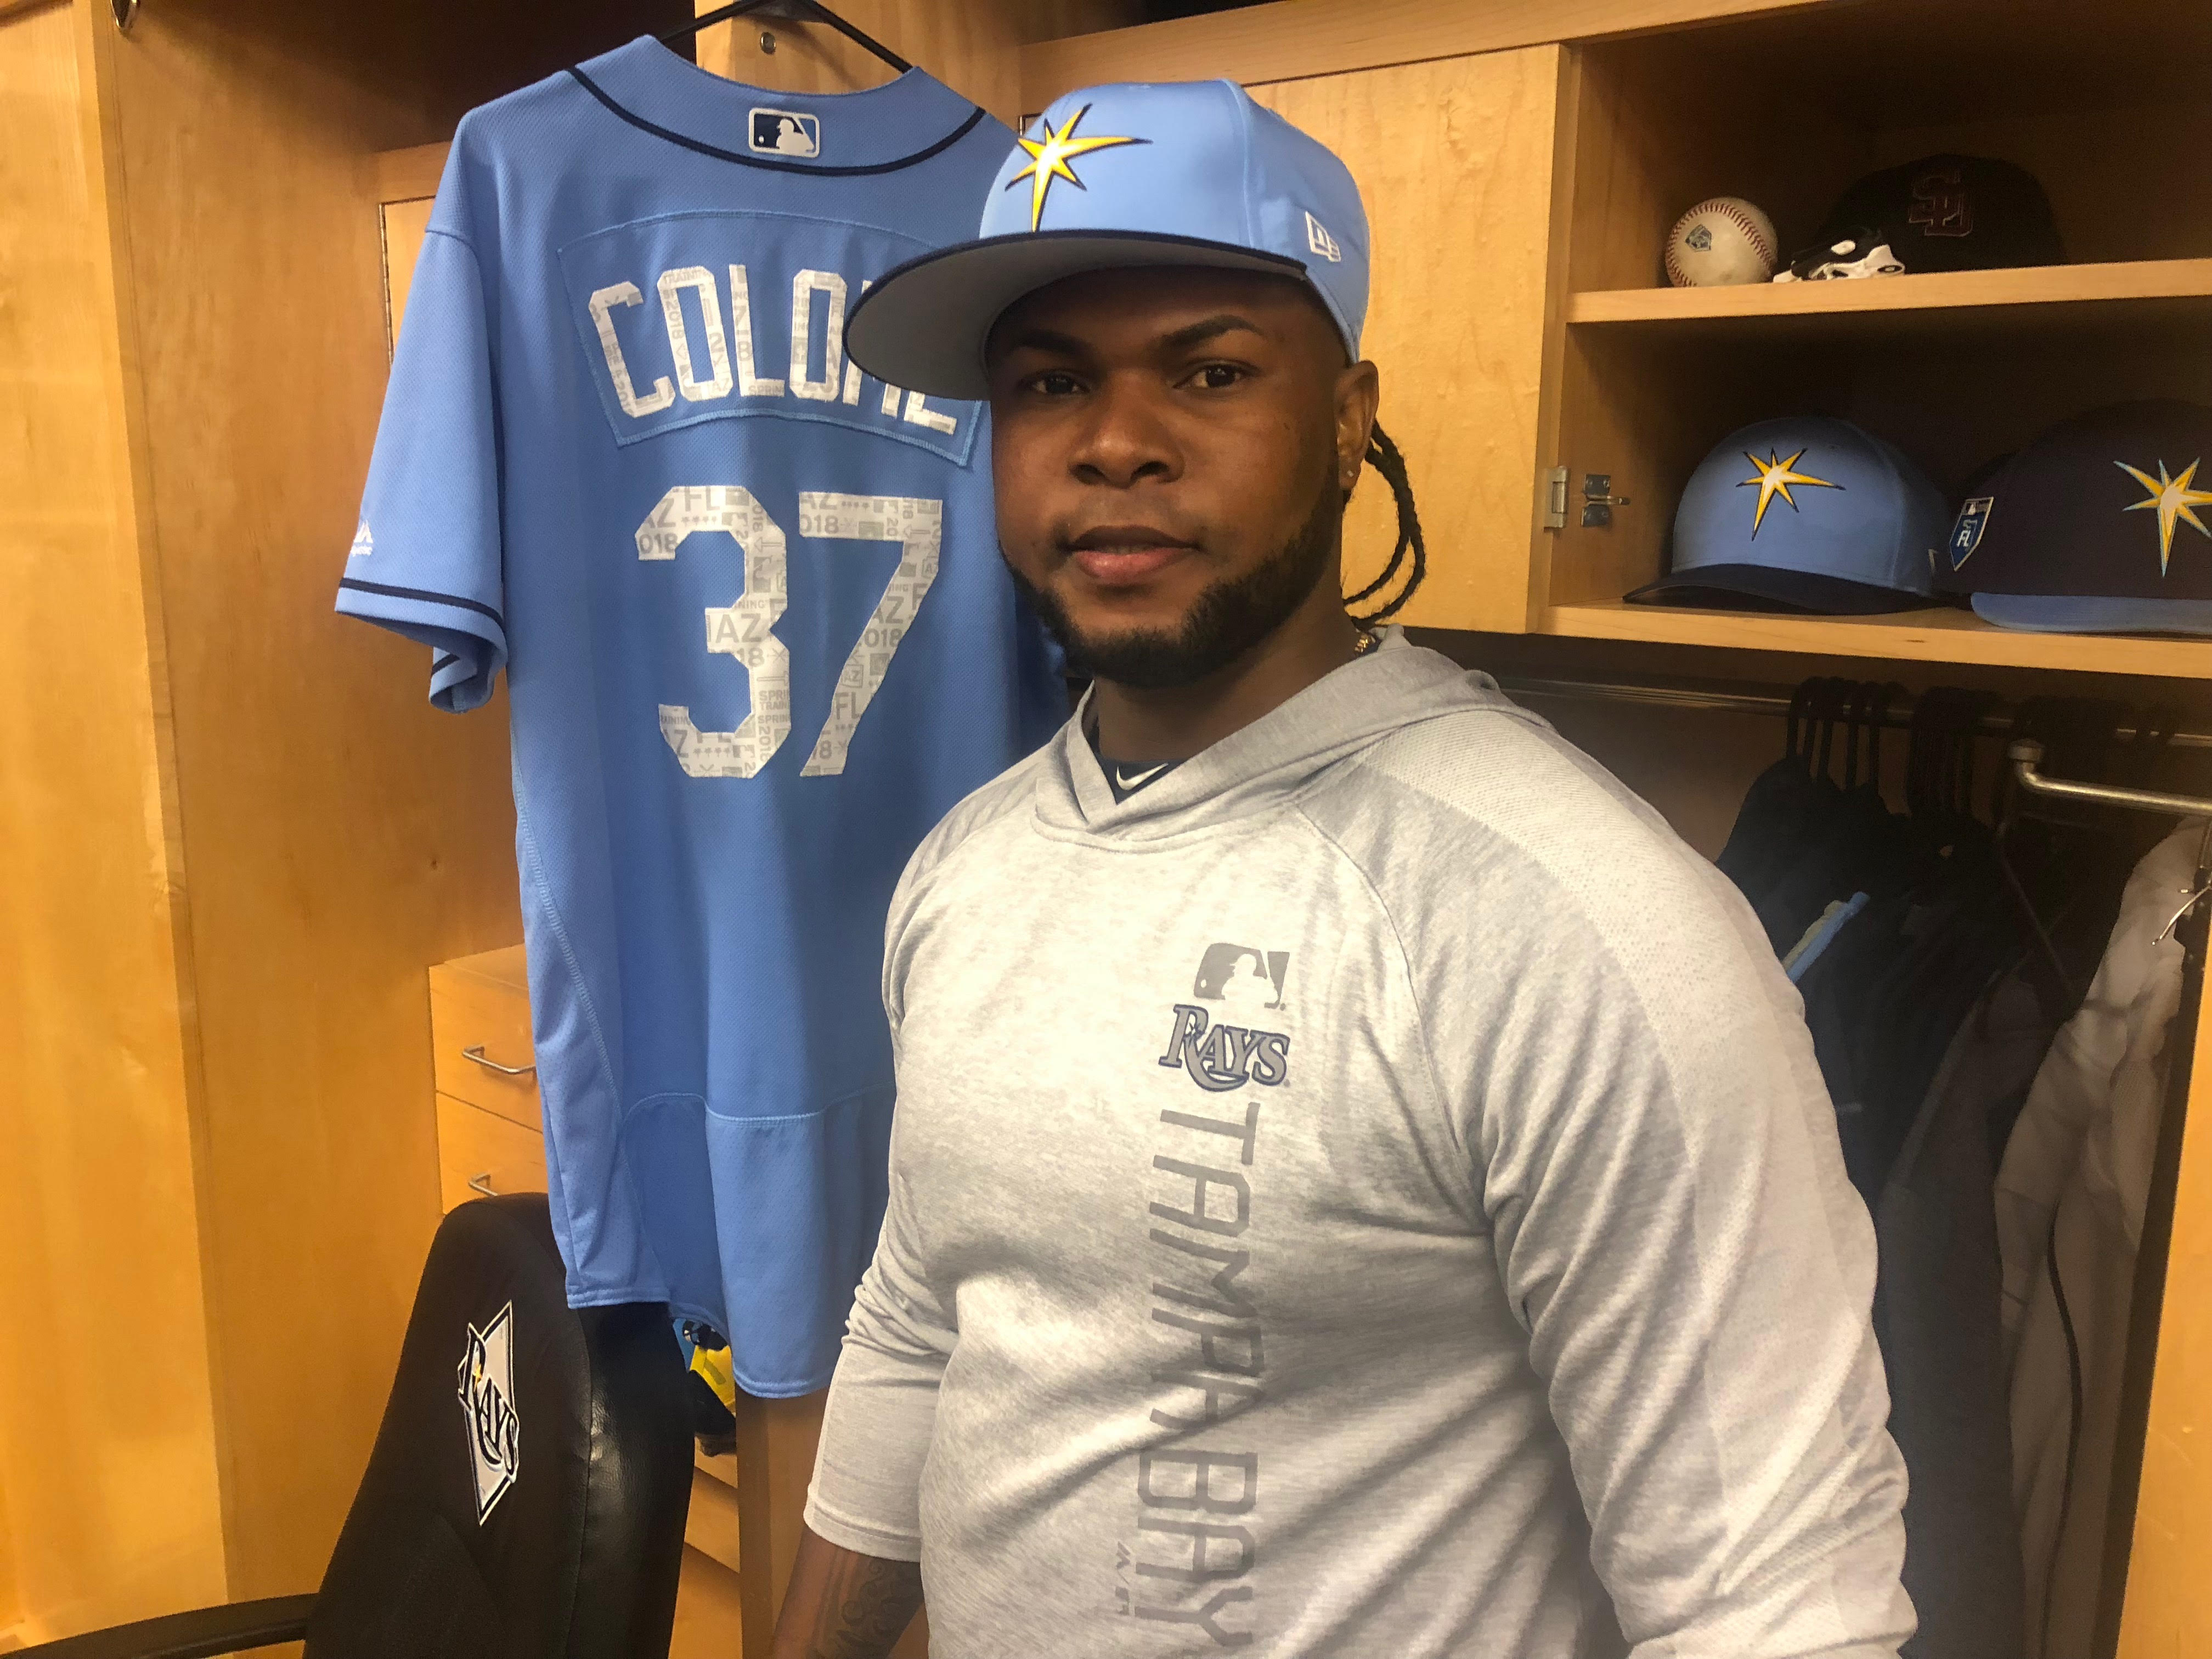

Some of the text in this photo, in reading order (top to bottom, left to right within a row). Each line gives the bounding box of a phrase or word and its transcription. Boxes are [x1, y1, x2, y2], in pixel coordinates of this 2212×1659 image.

[635, 485, 943, 779] 37
[1135, 1102, 1265, 1646] TAMPA BAY
